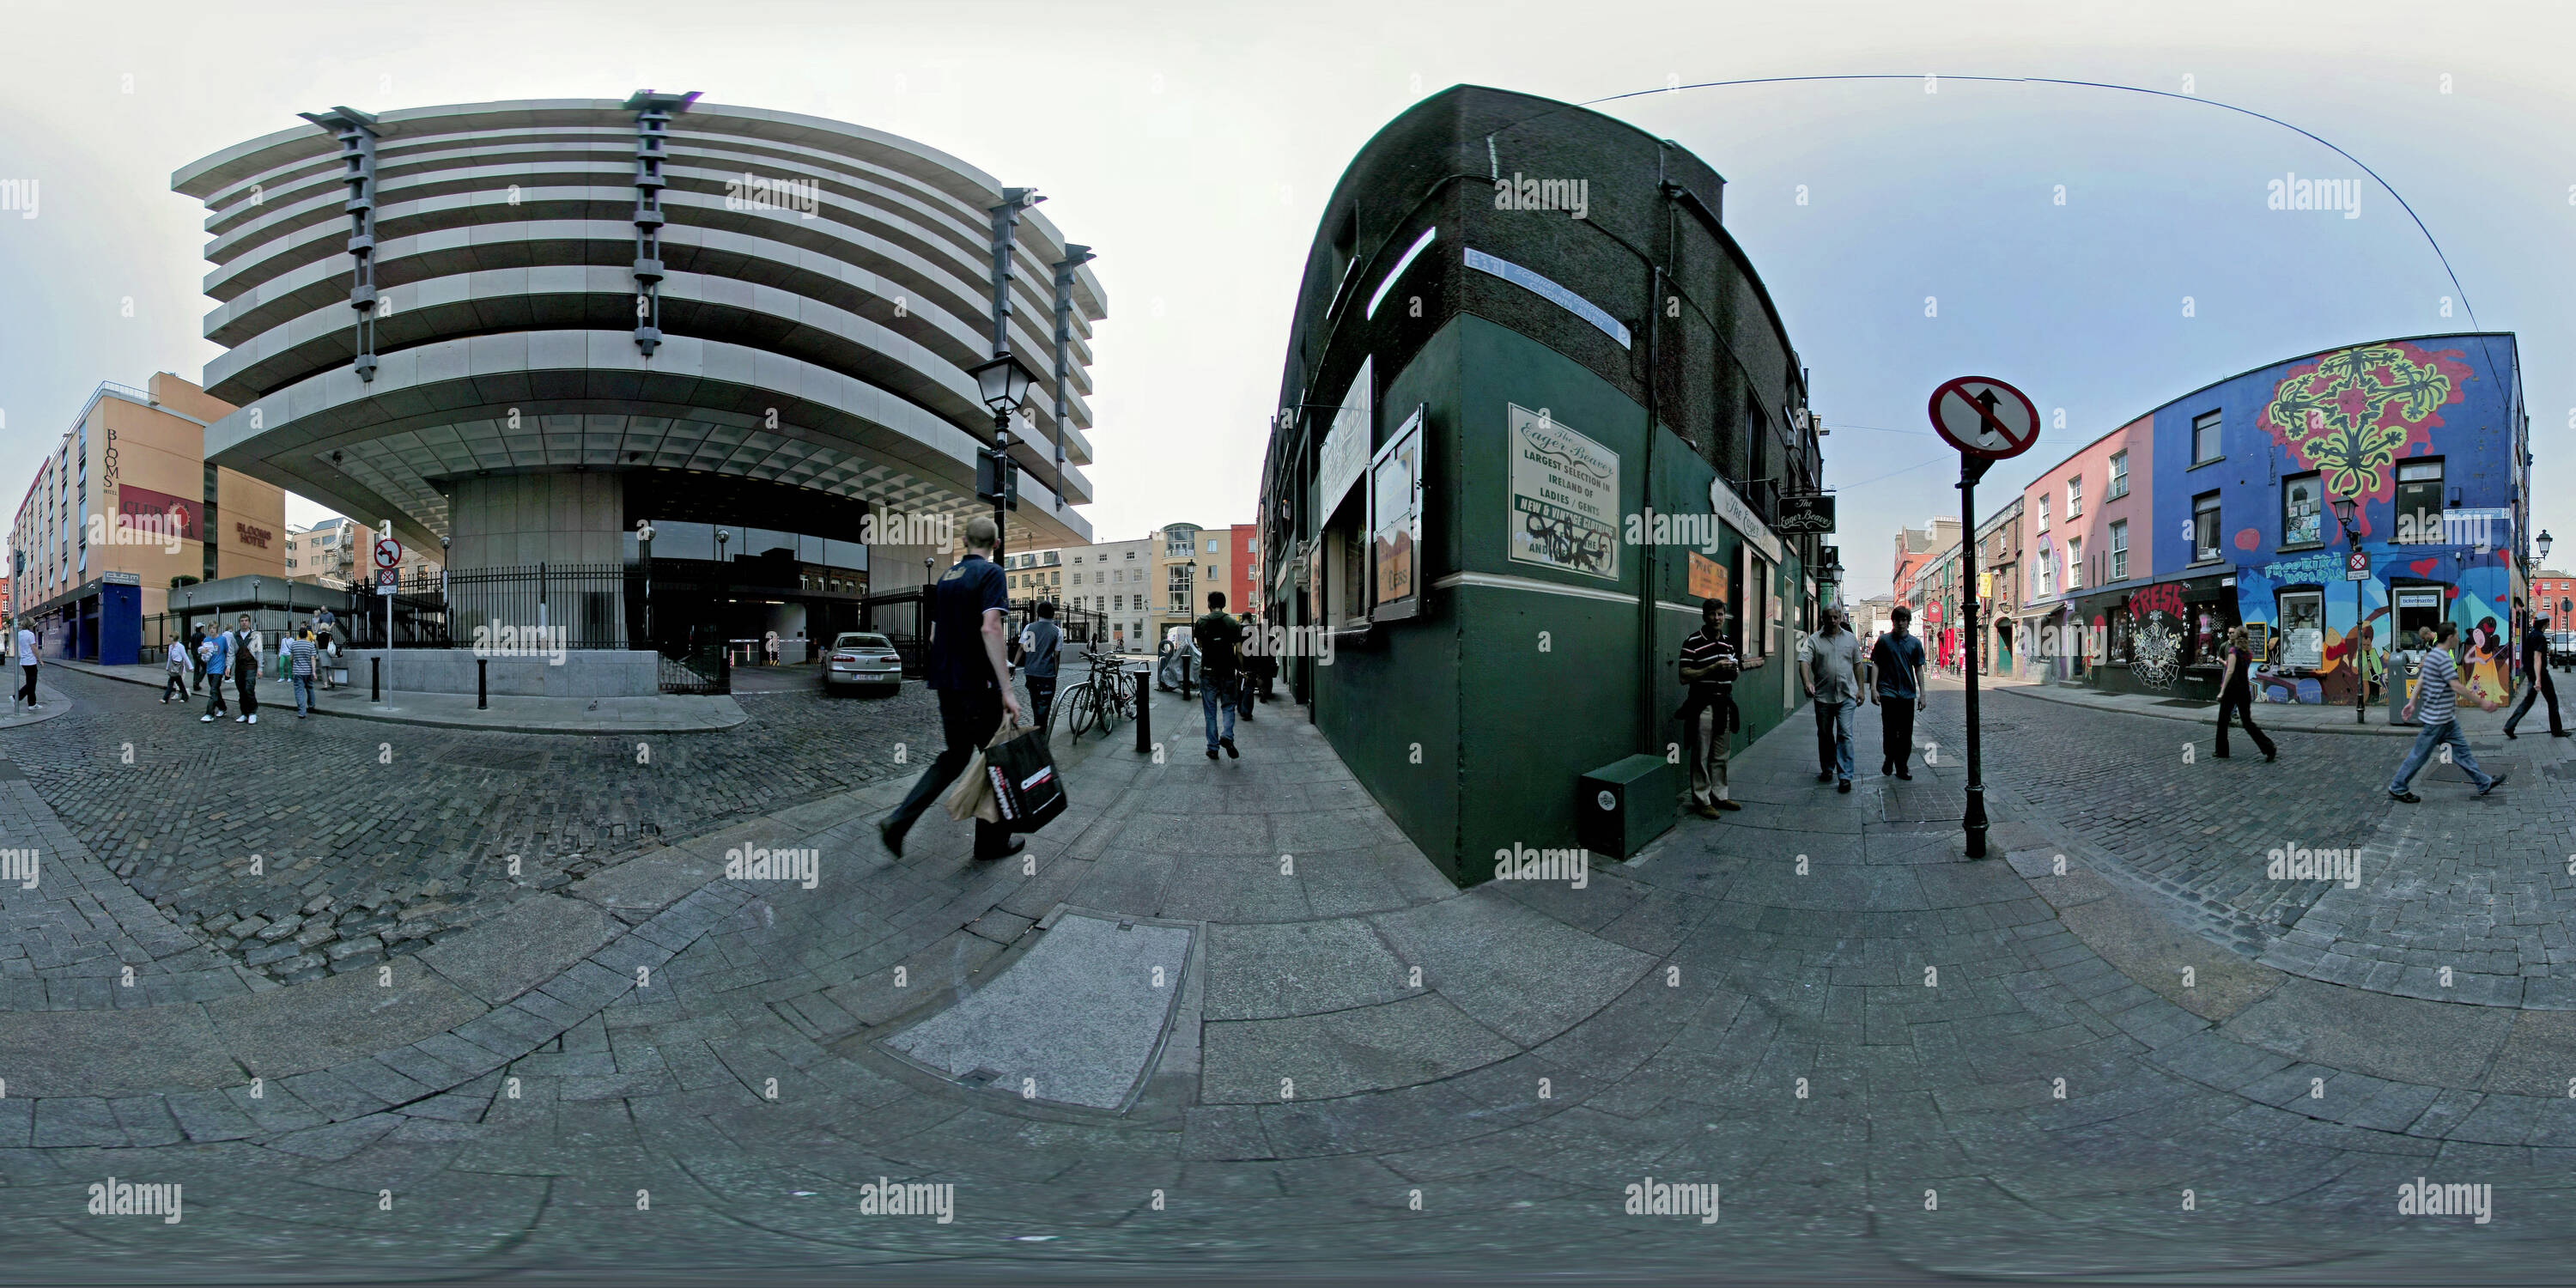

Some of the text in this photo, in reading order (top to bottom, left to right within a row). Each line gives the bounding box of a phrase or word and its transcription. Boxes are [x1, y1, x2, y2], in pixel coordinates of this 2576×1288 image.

[1529, 283, 1605, 326] CROWN ALLEY
[1521, 422, 1614, 475] Eager Beaver
[1554, 430, 1573, 443] The
[103, 428, 118, 488] BLOOMS
[1524, 449, 1611, 493] LARGEST SELECTION IN
[1549, 473, 1594, 499] IRELAND OF
[1520, 498, 1542, 513] NEW
[1542, 505, 1550, 516] &
[1552, 507, 1583, 526] VINAGE
[1540, 487, 1570, 505] LADIES
[1577, 501, 1600, 516] GENTS
[1726, 497, 1742, 521] The
[1795, 498, 1813, 507] The
[236, 521, 271, 541] BLOOMS
[1780, 509, 1832, 528] Eager Beaver
[240, 532, 268, 550] HOTEL
[2129, 583, 2185, 622] FRESH
